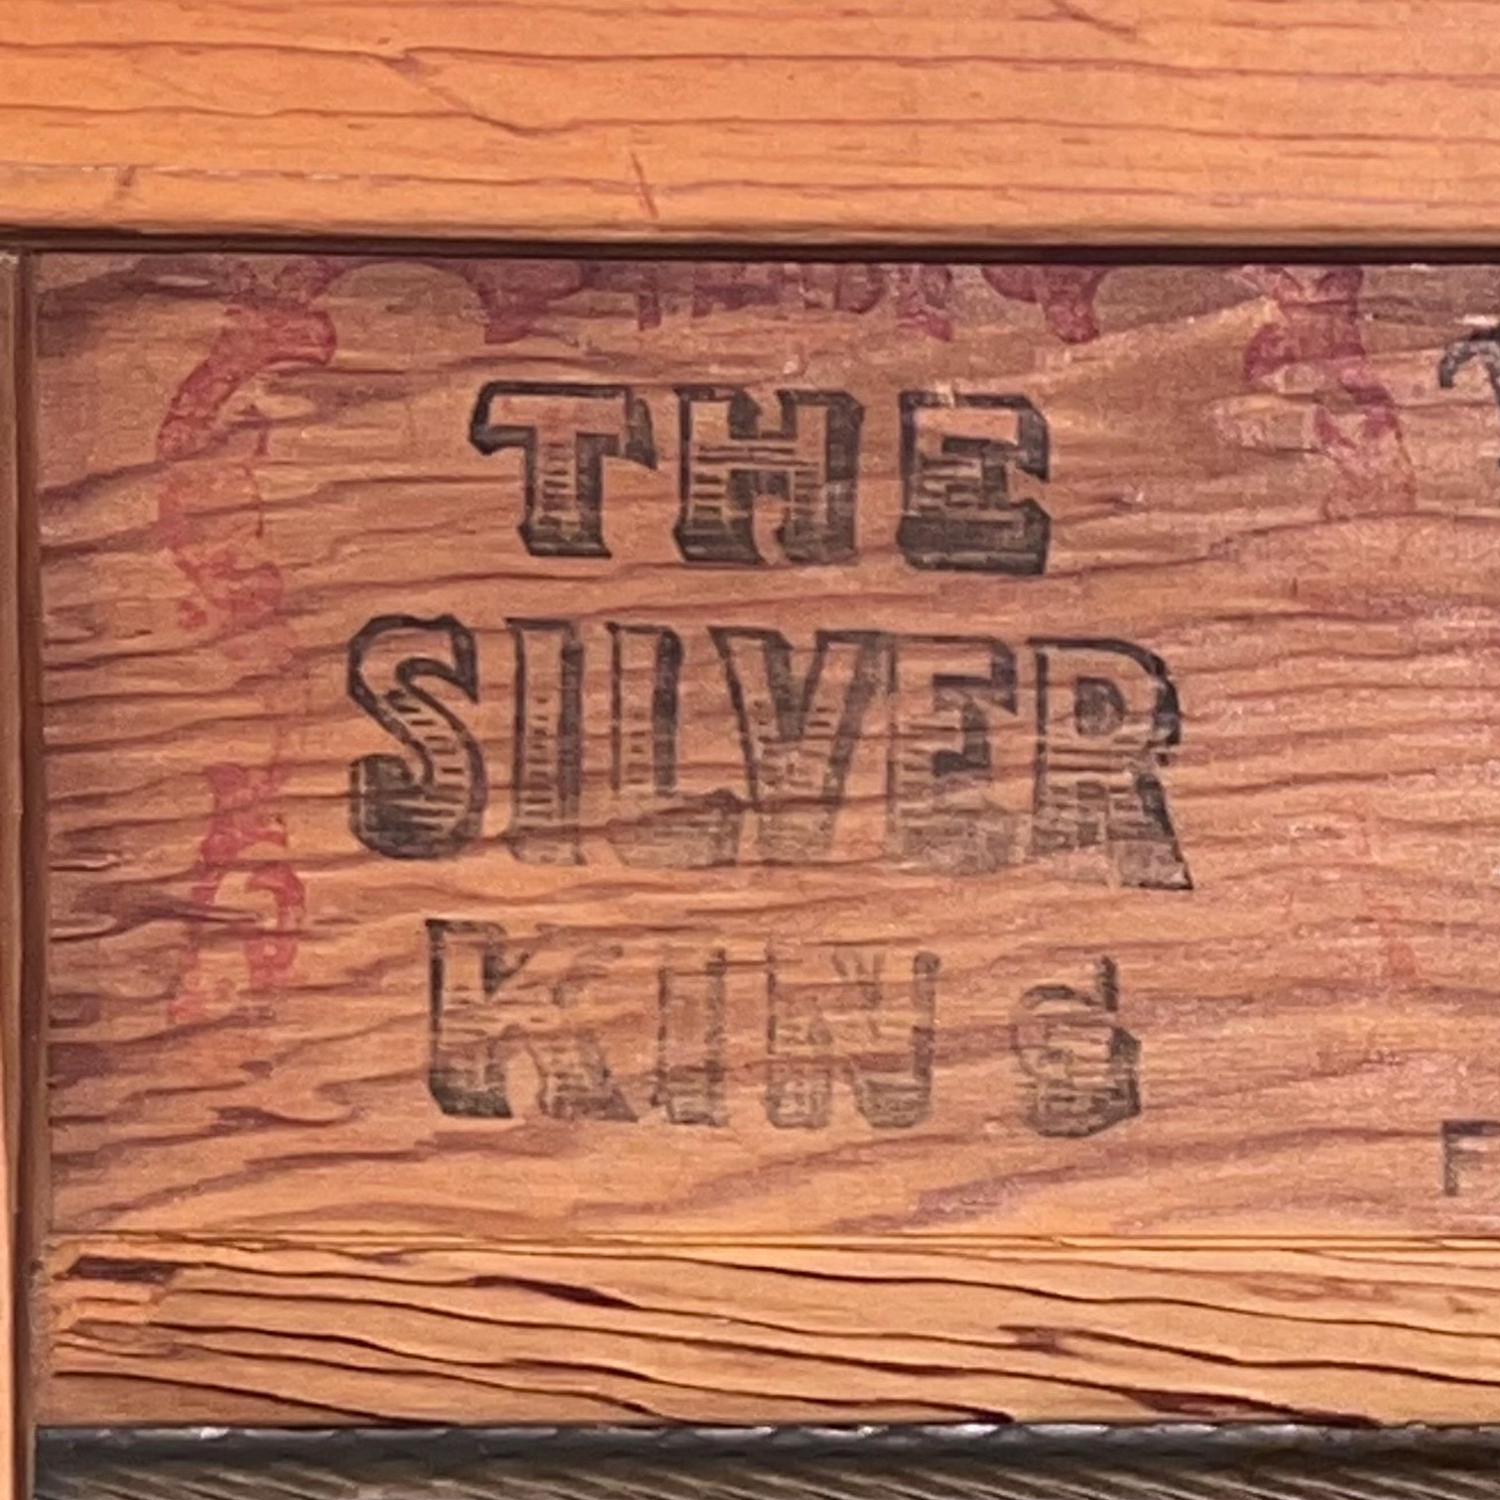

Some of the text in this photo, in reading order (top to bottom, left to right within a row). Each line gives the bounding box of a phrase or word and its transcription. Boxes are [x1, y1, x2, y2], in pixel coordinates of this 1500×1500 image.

[469, 379, 1051, 574] THE
[345, 612, 1194, 892] SILVER
[424, 915, 1144, 1139] KING
